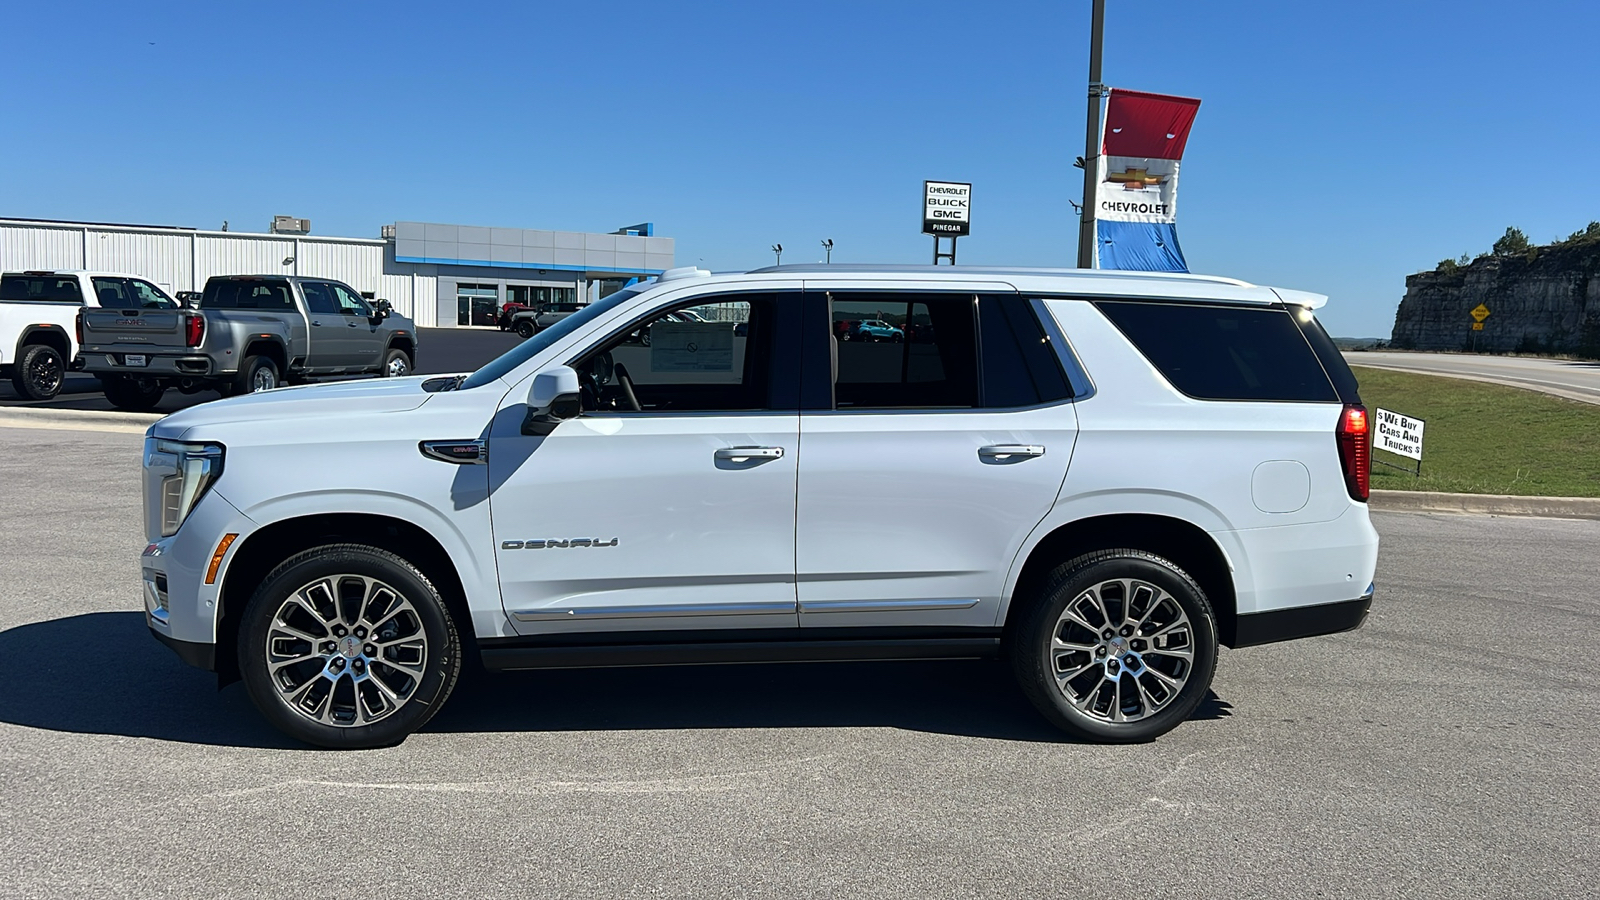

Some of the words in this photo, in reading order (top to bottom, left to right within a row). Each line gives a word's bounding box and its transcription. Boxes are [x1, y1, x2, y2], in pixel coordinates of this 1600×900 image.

[930, 187, 967, 195] CHEVROLET
[928, 198, 967, 207] BUICK
[1102, 202, 1168, 214] CHEVROLET
[933, 210, 961, 218] GMC
[502, 537, 618, 550] DENALI
